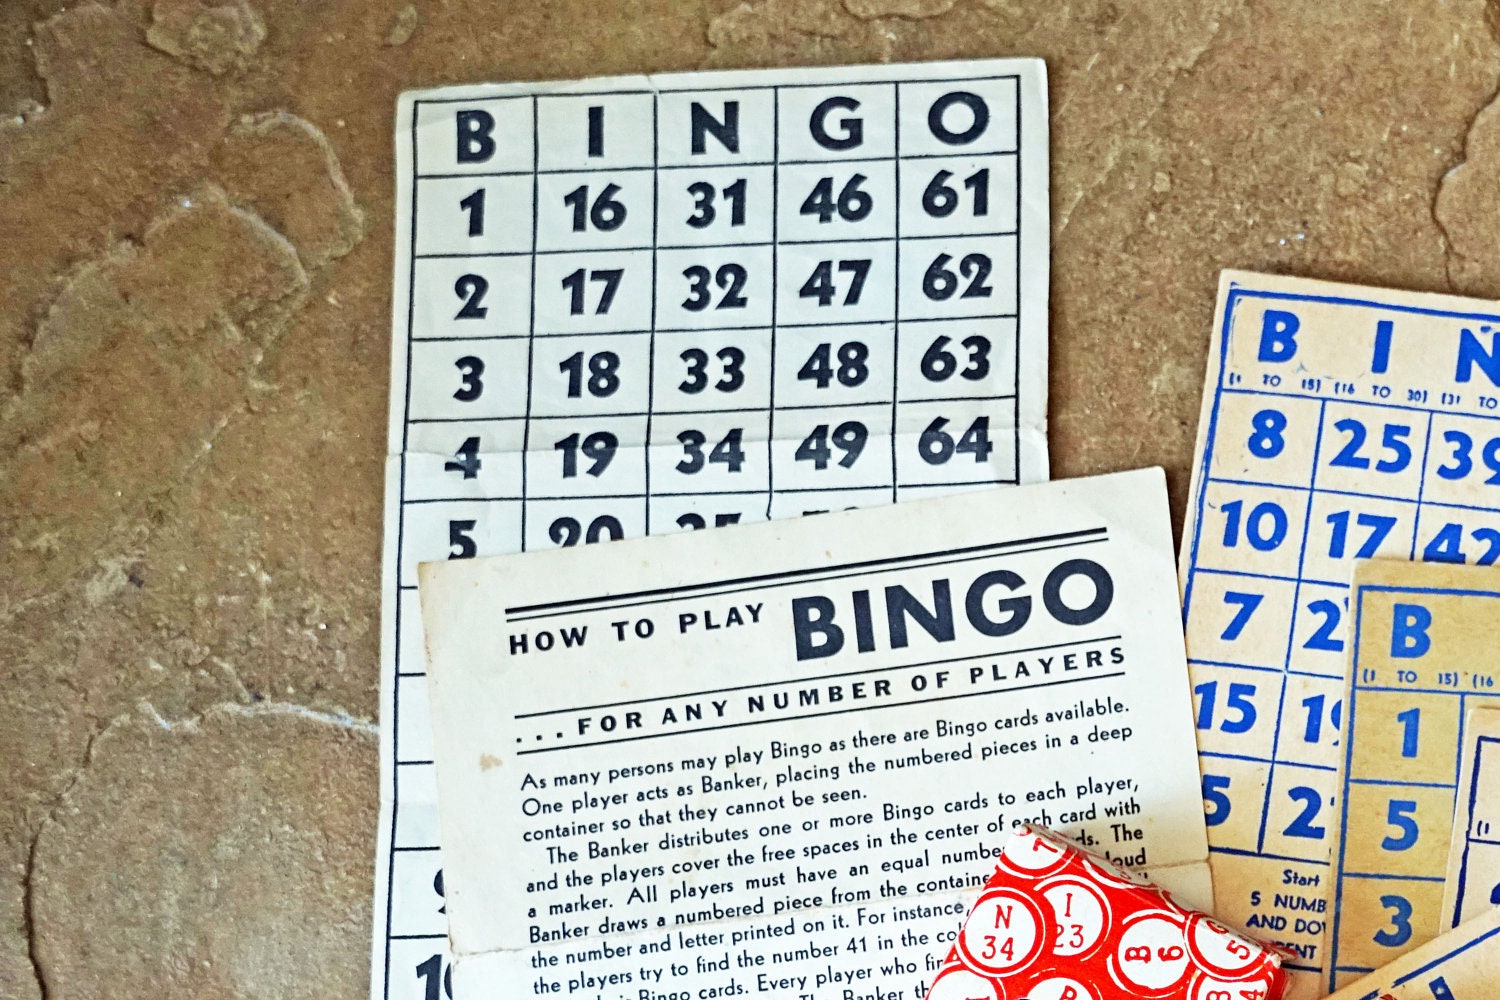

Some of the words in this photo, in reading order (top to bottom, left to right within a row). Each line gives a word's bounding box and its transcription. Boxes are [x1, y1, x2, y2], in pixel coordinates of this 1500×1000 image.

[460, 188, 486, 238] 1
[564, 183, 627, 232] 16
[686, 178, 747, 229] 31
[799, 173, 873, 224] 46
[922, 168, 990, 218] 61
[453, 273, 489, 321] 2
[561, 268, 625, 316] 17
[681, 263, 748, 312] 32
[798, 259, 872, 307] 47
[922, 253, 993, 301] 62
[453, 355, 485, 402] 3
[559, 351, 620, 398] 18
[678, 346, 745, 395] 33
[797, 341, 869, 389] 48
[920, 335, 992, 382] 63
[554, 431, 619, 479] 19
[675, 428, 745, 475] 34
[795, 421, 869, 470] 49
[918, 416, 993, 465] 64
[1247, 409, 1287, 459] 8
[1329, 418, 1412, 473] 25
[1221, 500, 1288, 551] 10
[509, 626, 588, 656] HOW
[611, 618, 655, 642] TO
[679, 603, 763, 634] PLAY
[792, 558, 1114, 661] BINGO
[662, 700, 727, 725] ANY
[748, 679, 891, 713] NUMBER
[911, 671, 950, 692] OF
[969, 647, 1124, 684] PLAYERS
[520, 773, 547, 791] As
[554, 771, 601, 787] many
[608, 762, 674, 784] persons
[681, 756, 717, 771] may
[725, 745, 764, 769] play
[771, 741, 822, 759] Bingo
[829, 740, 846, 752] as
[852, 730, 897, 748] there
[903, 729, 929, 742] are
[936, 719, 987, 738] Bingo
[994, 708, 1039, 730] cards
[1045, 696, 1129, 723] available.
[522, 798, 563, 817] One
[572, 791, 628, 814] player
[636, 786, 669, 802] acts
[677, 785, 693, 797] as
[701, 772, 768, 794] Banker,
[776, 765, 840, 788] placing
[848, 756, 876, 774] the
[884, 742, 972, 770] numbered
[981, 740, 1037, 761] pieces
[1045, 734, 1061, 749] in
[1070, 735, 1079, 746] a
[1087, 725, 1133, 743] deep
